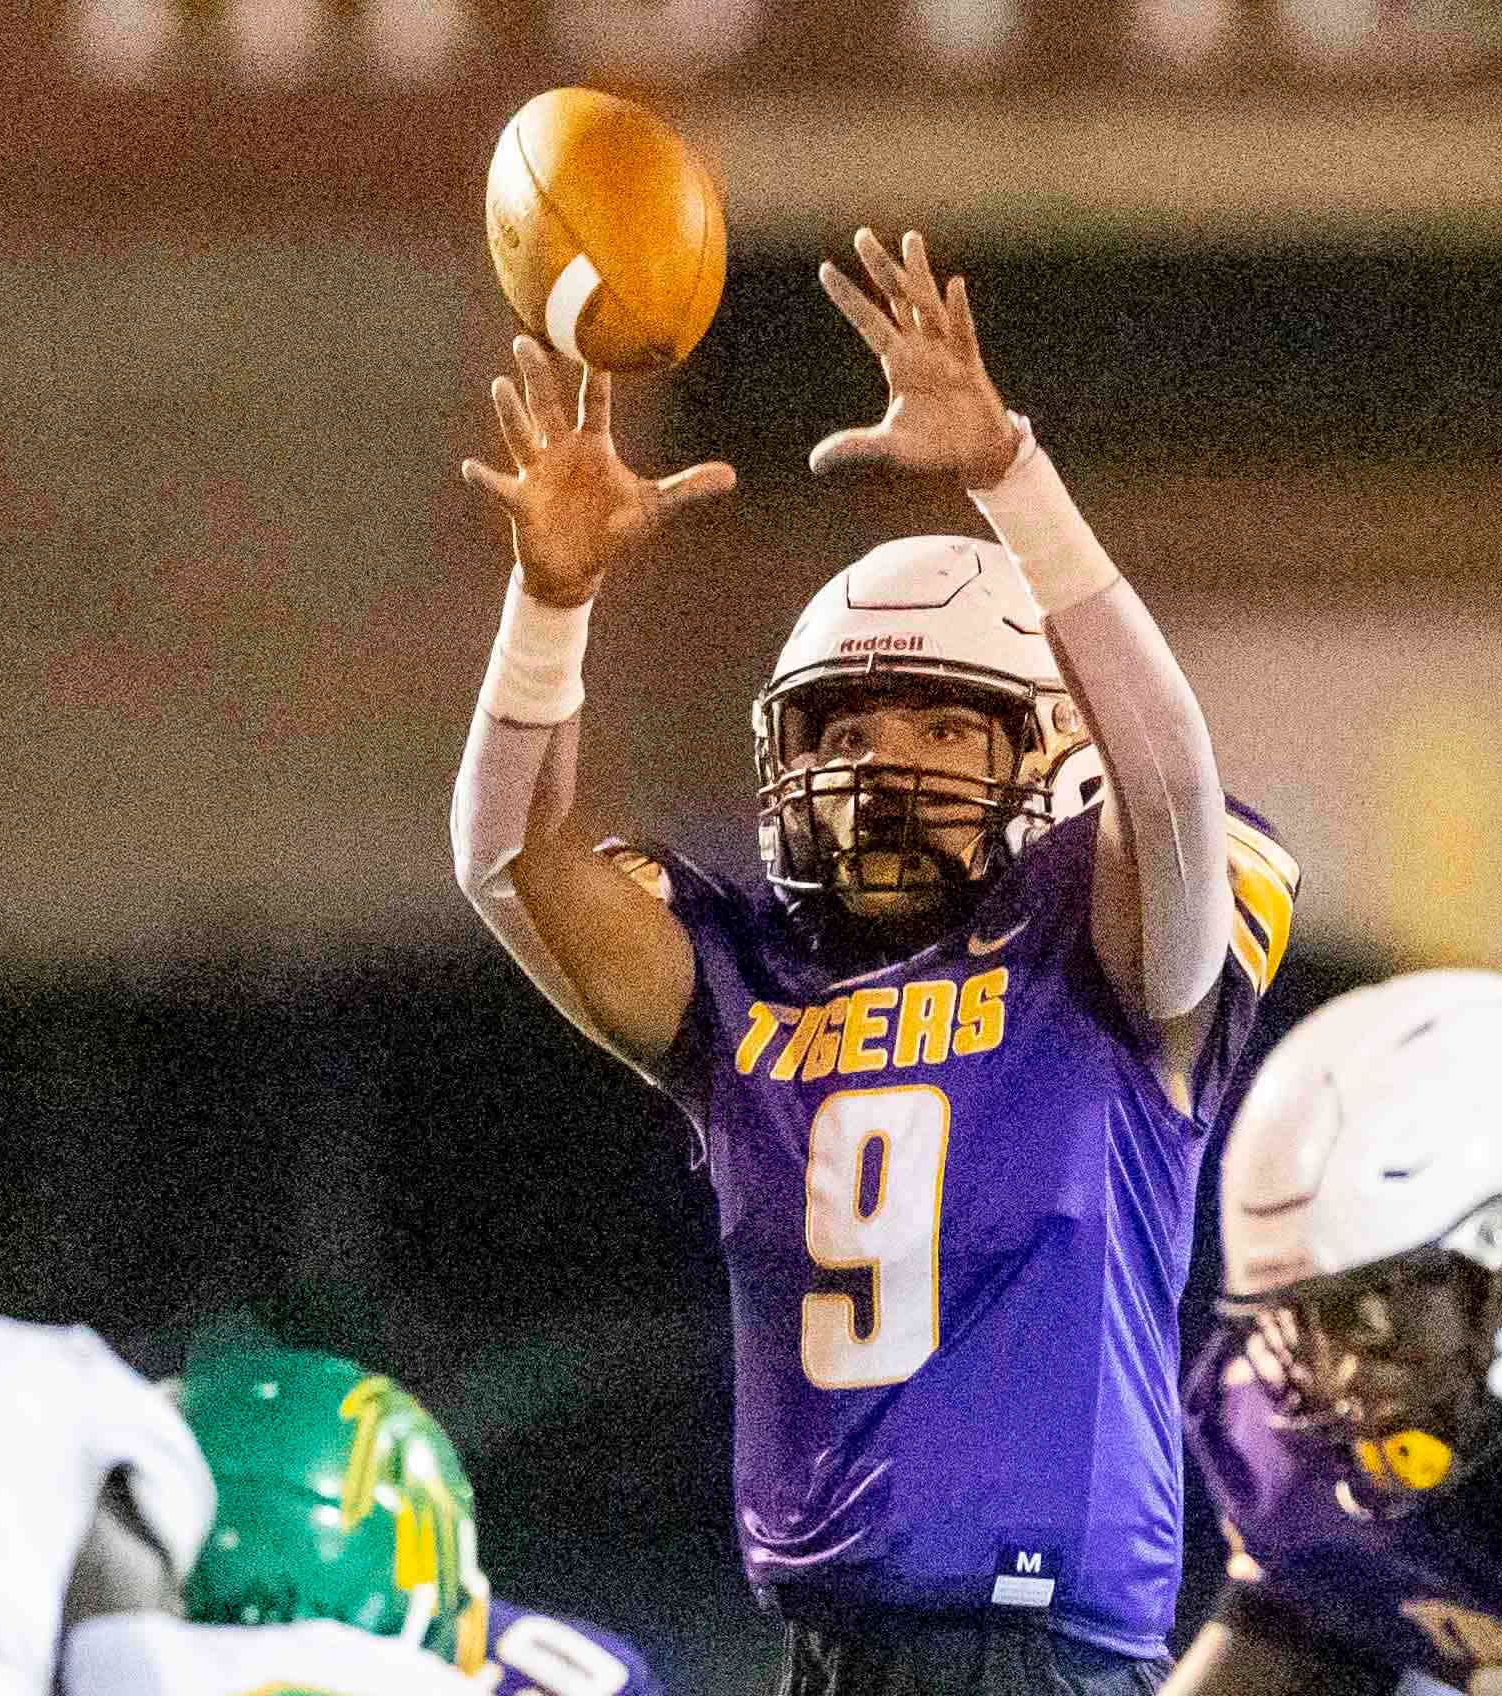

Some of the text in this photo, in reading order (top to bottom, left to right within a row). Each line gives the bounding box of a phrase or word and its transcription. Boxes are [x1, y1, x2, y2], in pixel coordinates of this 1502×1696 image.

[841, 634, 924, 652] Riddell
[735, 966, 1009, 1081] TIGERS
[801, 1084, 952, 1389] 9
[1016, 1551, 1042, 1574] M
